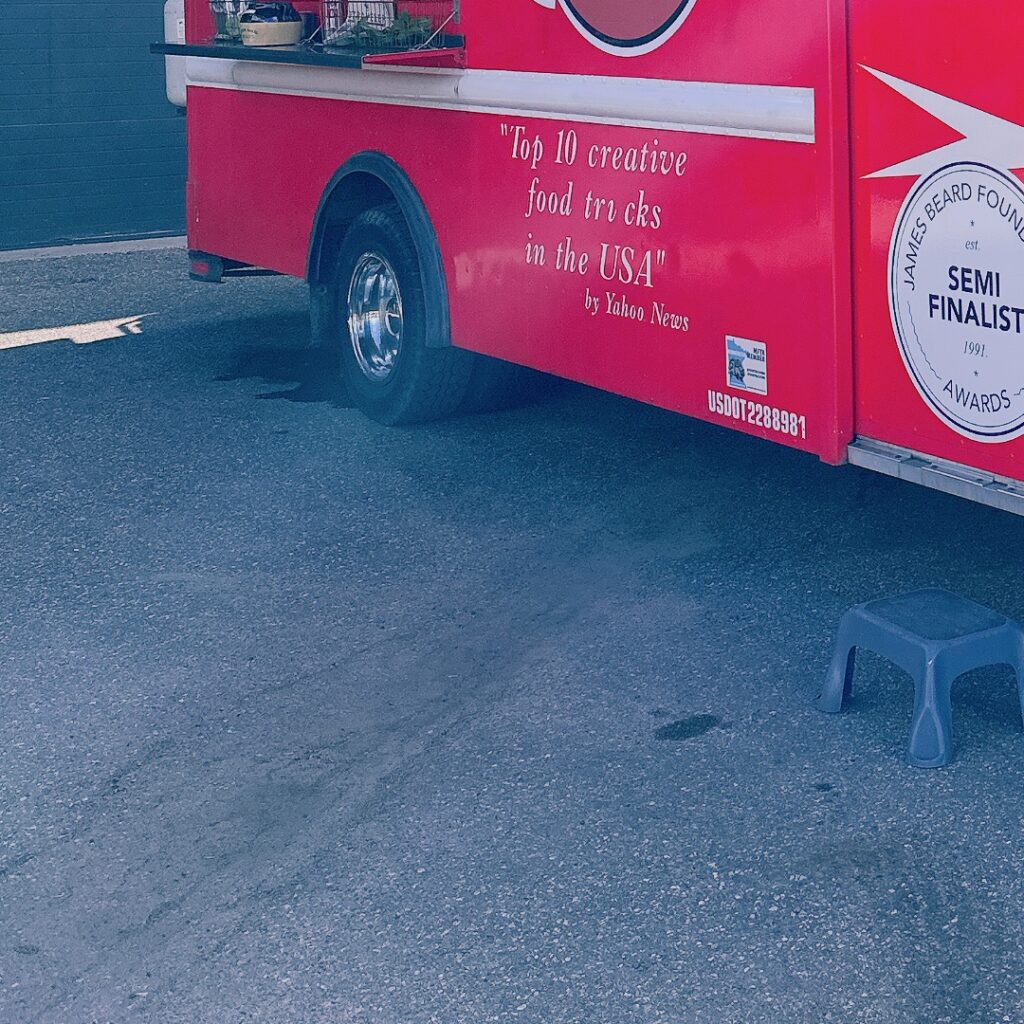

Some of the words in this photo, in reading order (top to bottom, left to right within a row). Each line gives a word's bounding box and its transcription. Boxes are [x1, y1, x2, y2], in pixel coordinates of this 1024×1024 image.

[500, 123, 544, 169] "Top
[554, 129, 578, 166] 10
[588, 138, 688, 176] creative
[524, 176, 573, 218] food
[903, 216, 928, 291] JAMES
[925, 182, 972, 222] BEARD
[964, 238, 981, 252] est.
[525, 232, 546, 267] in
[555, 236, 589, 276] the
[599, 242, 666, 288] USA"
[948, 265, 1001, 298] SEMI
[584, 287, 600, 316] by
[605, 291, 645, 322] Yahoo
[650, 301, 689, 332] News
[928, 293, 1024, 334] FINALIST
[943, 378, 1011, 414] AWARDS
